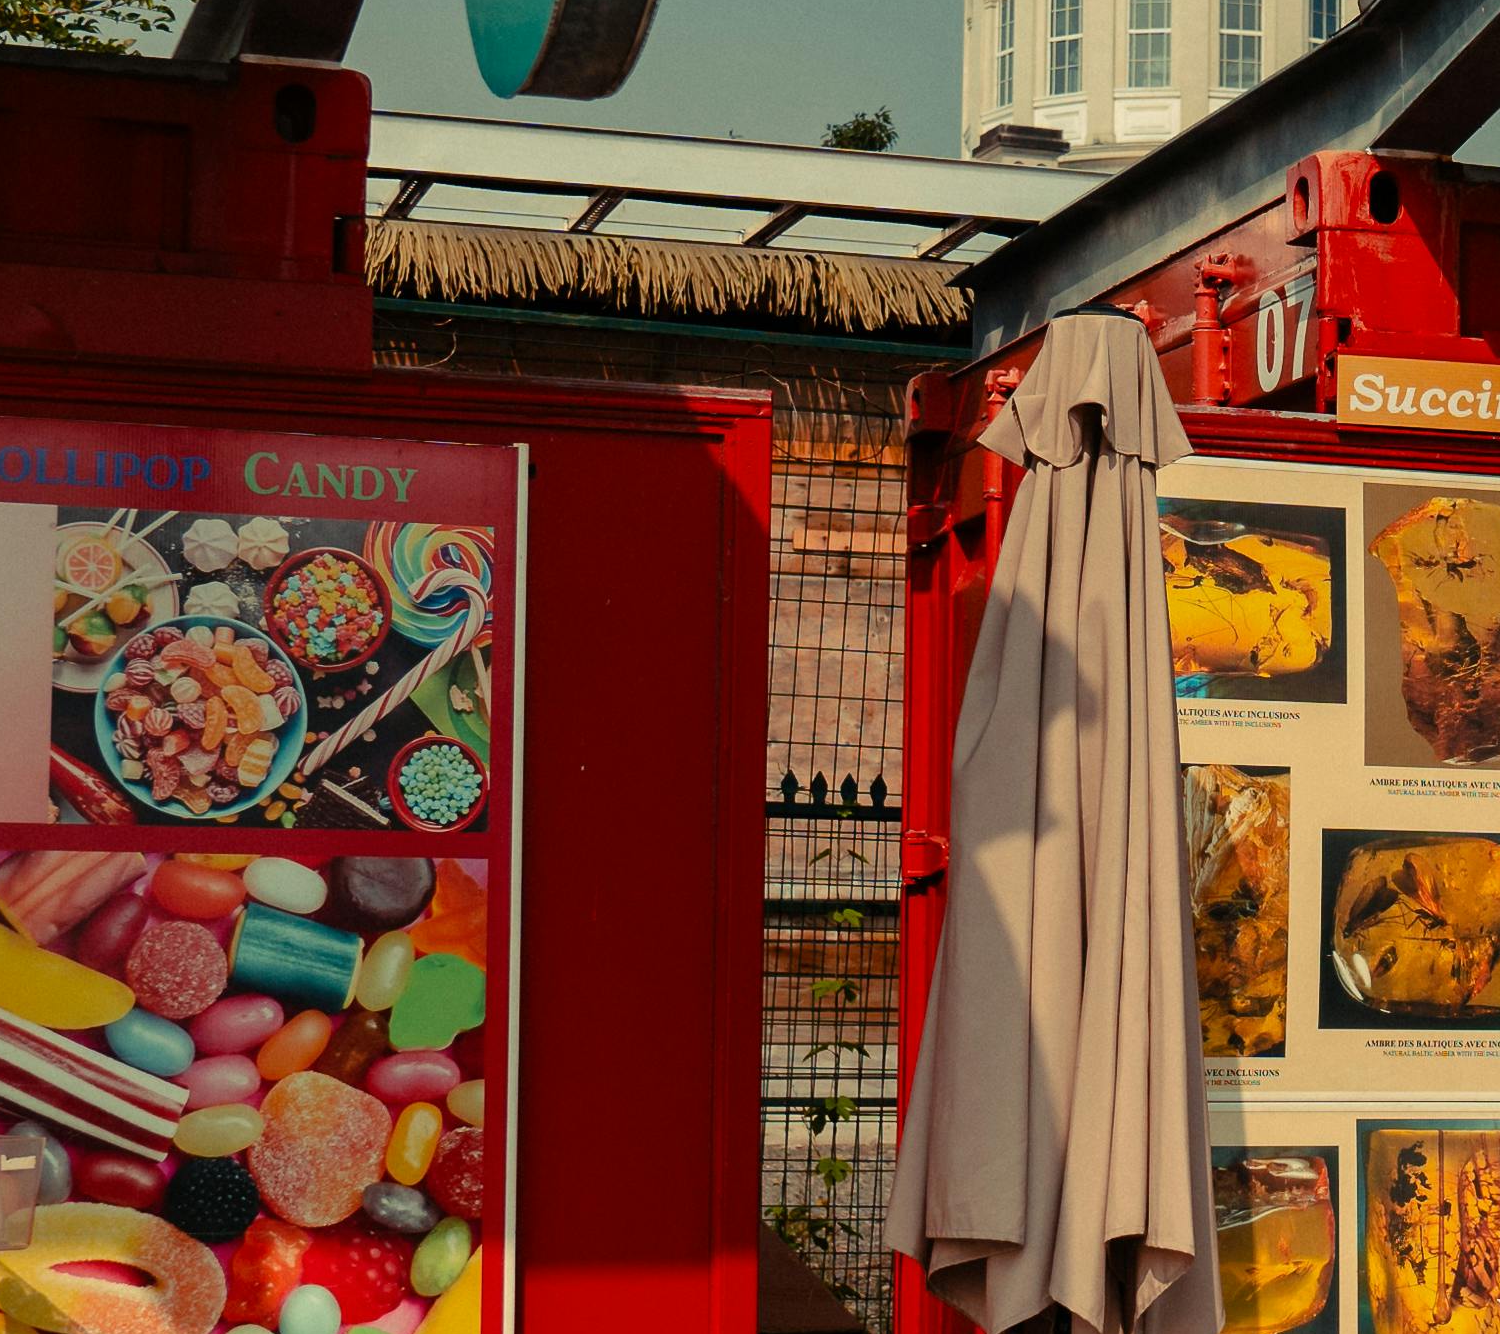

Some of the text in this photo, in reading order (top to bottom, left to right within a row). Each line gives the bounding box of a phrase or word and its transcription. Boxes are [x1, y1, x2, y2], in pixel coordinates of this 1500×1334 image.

[1257, 274, 1316, 393] 07
[243, 451, 418, 503] CANDY
[1177, 708, 1300, 720] ALTIQUES AVEC INCLUSIONS
[1369, 778, 1401, 787] AMBRE
[1402, 779, 1419, 787] DES
[1420, 780, 1467, 789] BALTIQUES
[1468, 781, 1491, 789] AVEC
[1365, 1040, 1397, 1048] AMBRE
[1398, 1040, 1415, 1048] DES
[1416, 1040, 1463, 1048] BALTIQUES
[1464, 1040, 1487, 1048] AVEC
[1226, 1069, 1280, 1077] INCLUSIONS
